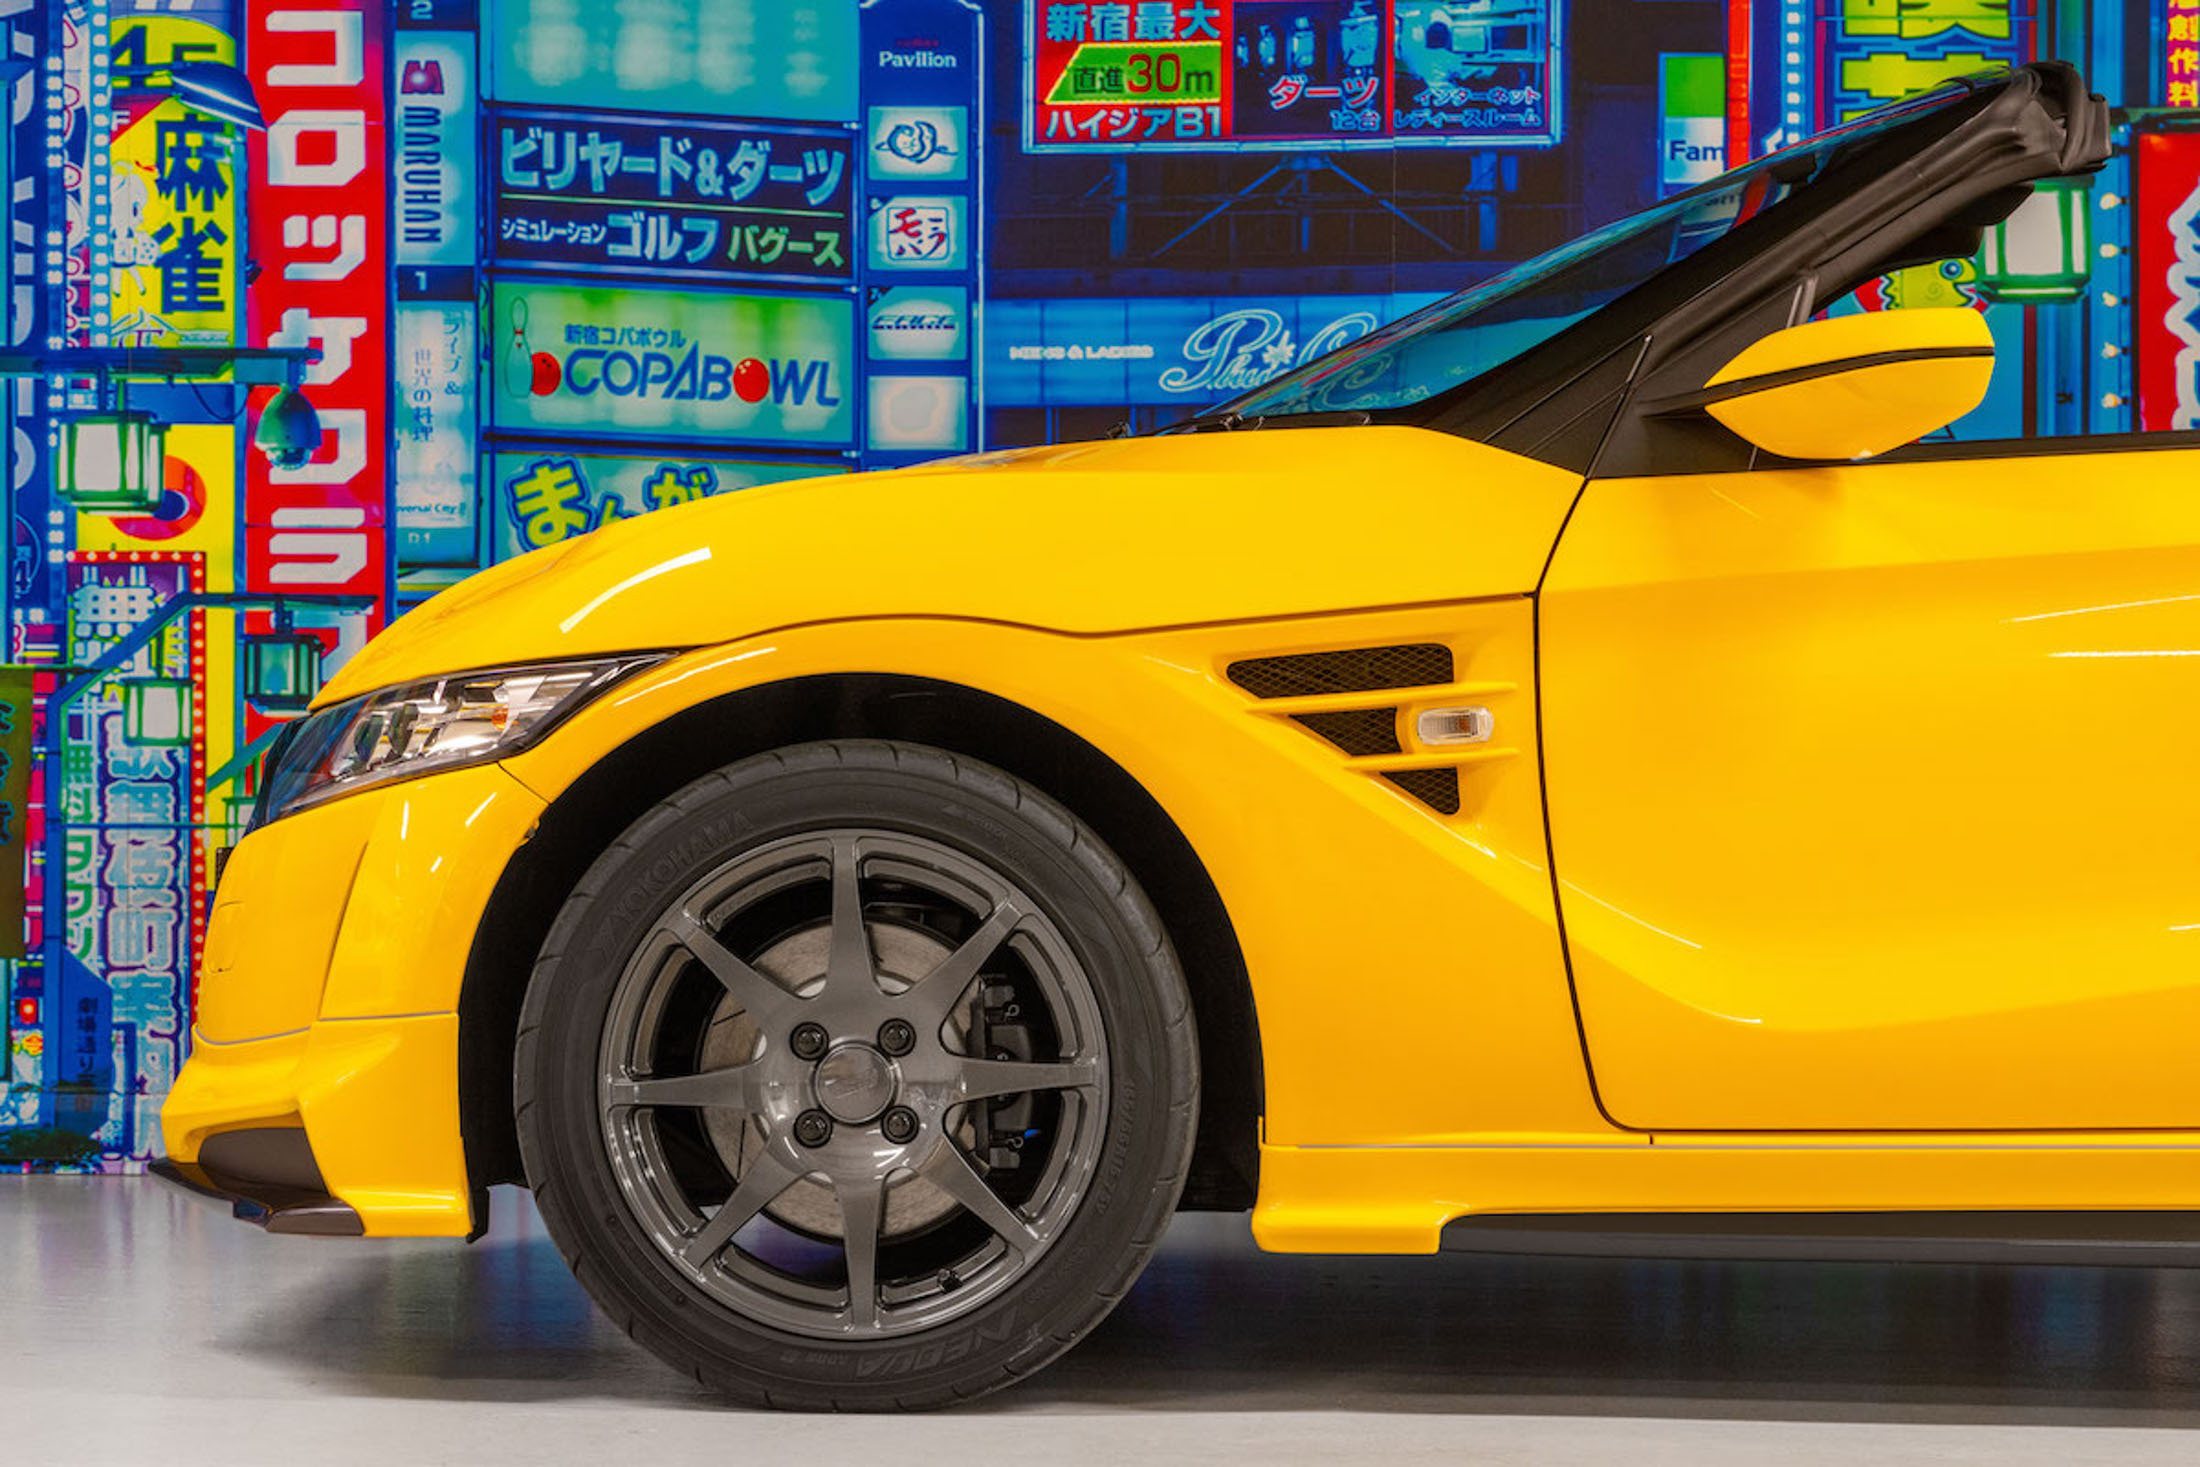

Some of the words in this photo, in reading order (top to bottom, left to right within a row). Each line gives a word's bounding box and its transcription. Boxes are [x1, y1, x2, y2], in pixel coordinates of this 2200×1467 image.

[1046, 1, 1221, 42] 新宿最大
[879, 51, 957, 67] Pavilion
[2168, 0, 2199, 107] 創作料
[1269, 75, 1379, 110] ダーツ
[1414, 86, 1540, 107] インターネット
[1045, 107, 1222, 138] ハイジアB1
[404, 106, 443, 243] MARUHAN
[501, 127, 846, 206] ビリヤード&ダーツ
[153, 113, 229, 315] 麻雀
[728, 226, 845, 269] バグース
[564, 323, 687, 348] 新宿コパボウル
